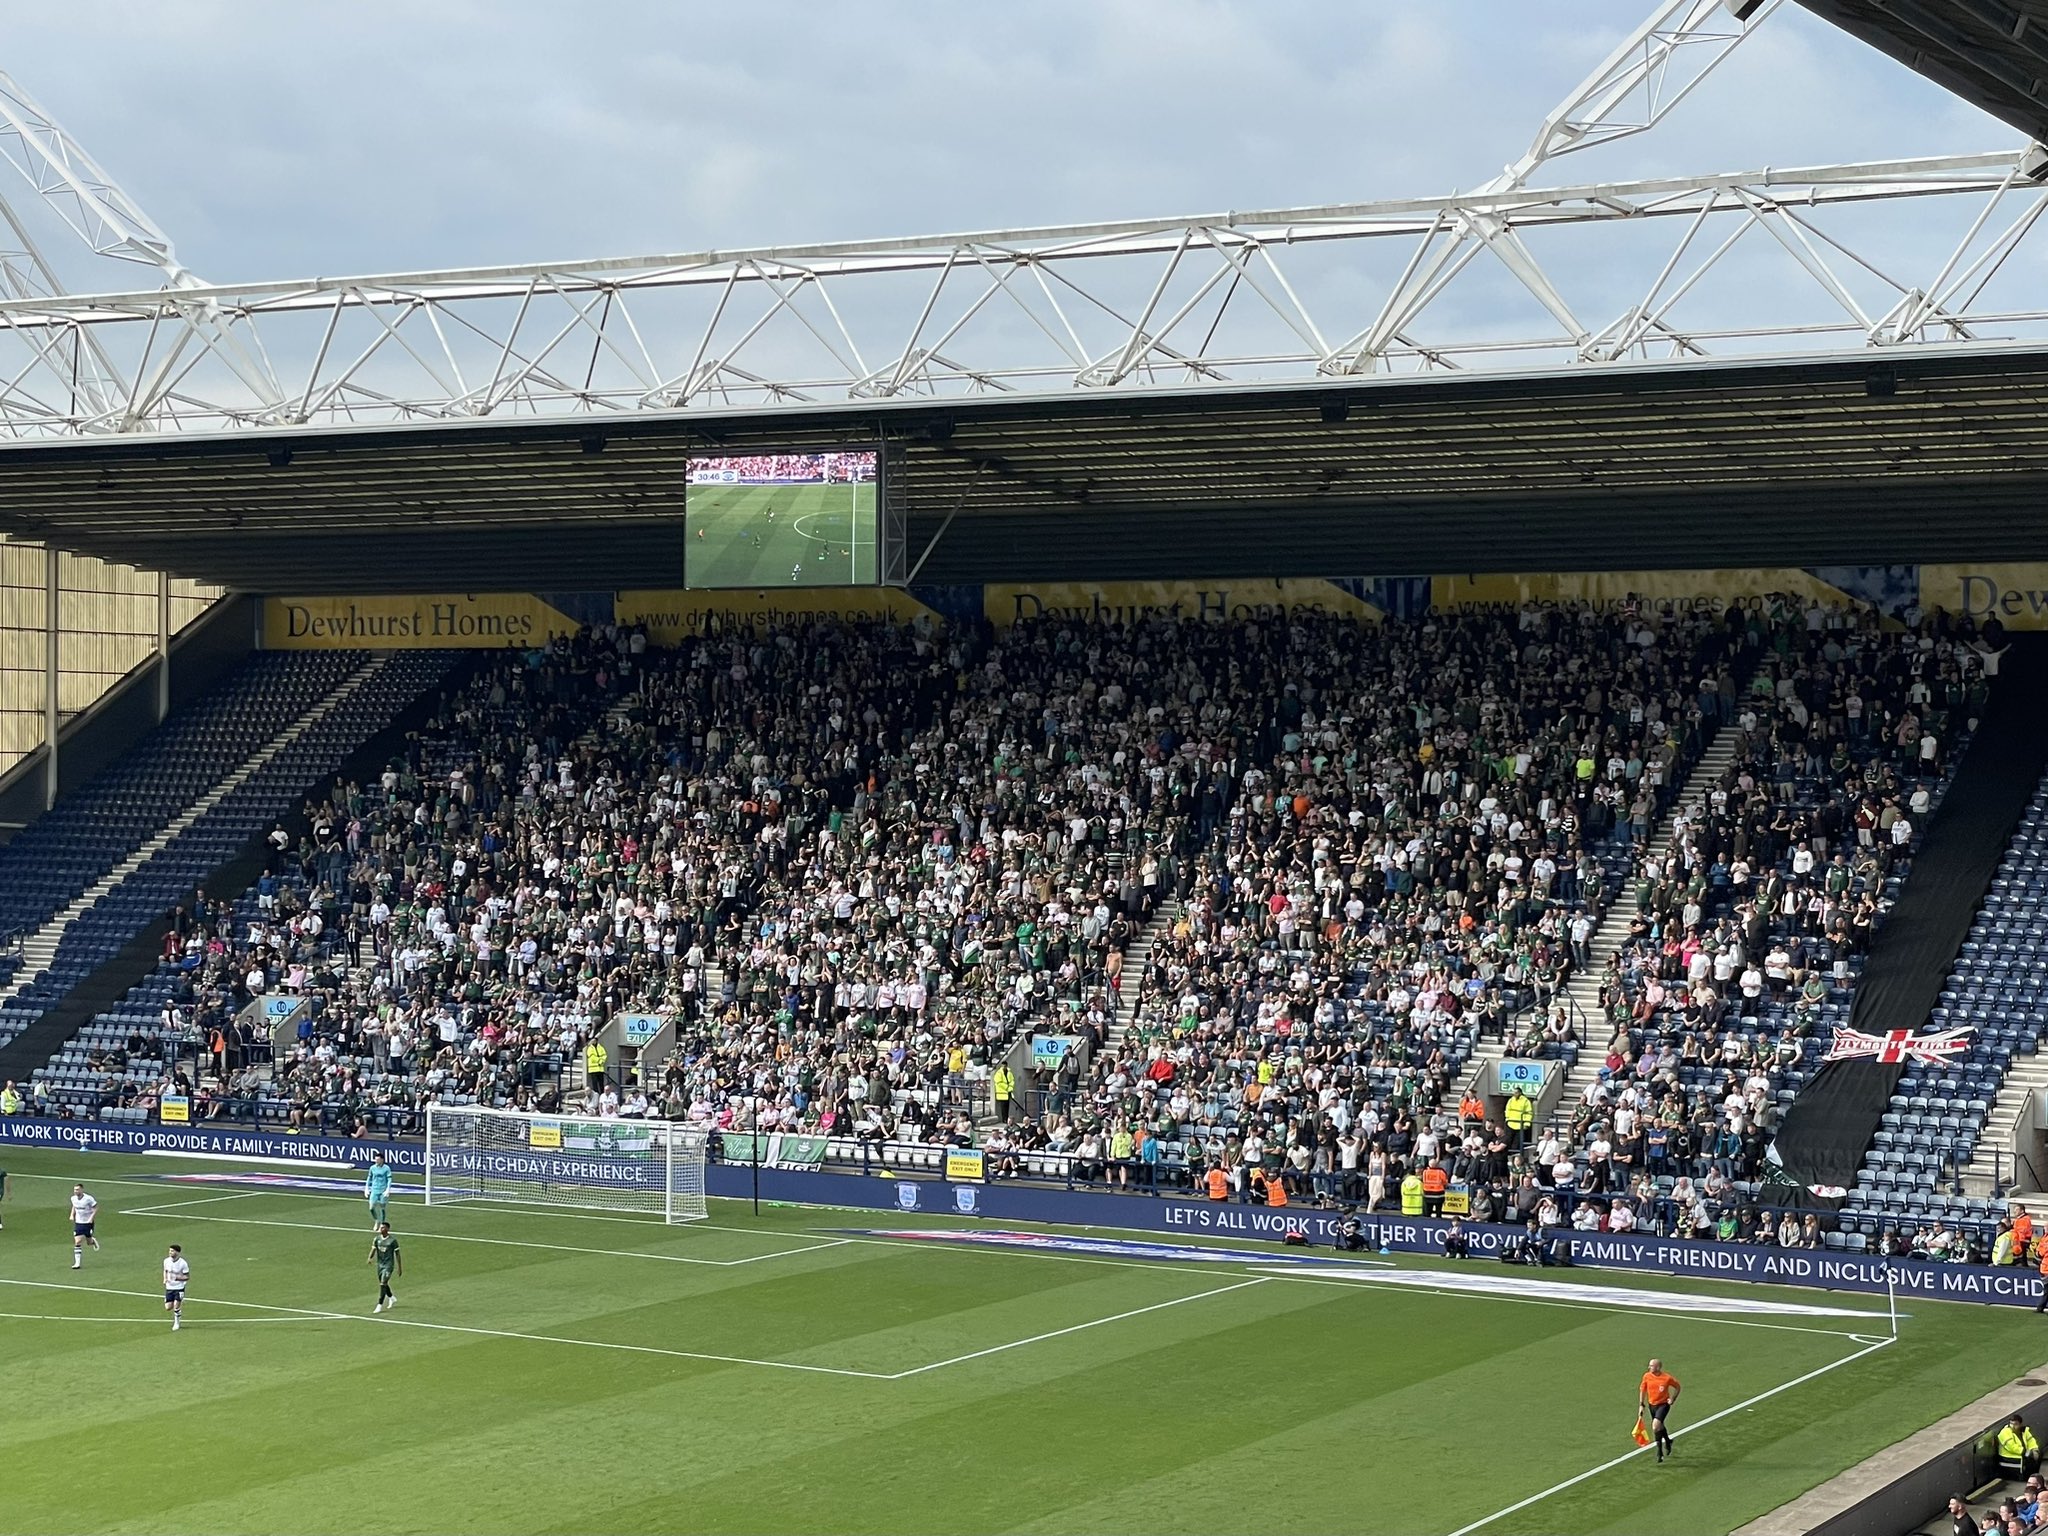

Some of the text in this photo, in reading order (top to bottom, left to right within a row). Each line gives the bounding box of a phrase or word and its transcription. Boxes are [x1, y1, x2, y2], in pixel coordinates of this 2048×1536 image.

[287, 604, 531, 638] Dewhurst Homes
[1047, 1042, 1058, 1051] 12
[1515, 1067, 1527, 1078] 13
[11, 1123, 52, 1140] WORK
[55, 1126, 124, 1144] TOGETHER
[127, 1132, 146, 1146] TO
[150, 1133, 208, 1150] PROVIDE
[211, 1137, 221, 1150] A
[225, 1138, 346, 1160] FAMILY-FRIENDLY
[384, 1150, 458, 1169] INCLUSIVE
[463, 1155, 548, 1175] MATCHDAY
[1165, 1207, 1210, 1226] LET'S
[1216, 1212, 1246, 1229] ALL
[1252, 1214, 1310, 1234] WORK
[1423, 1227, 1449, 1246] TO
[1570, 1240, 1757, 1271] FAMILY-FRIENDLY
[1763, 1256, 1811, 1276] AND
[1818, 1260, 1935, 1289] INCLUSIVE
